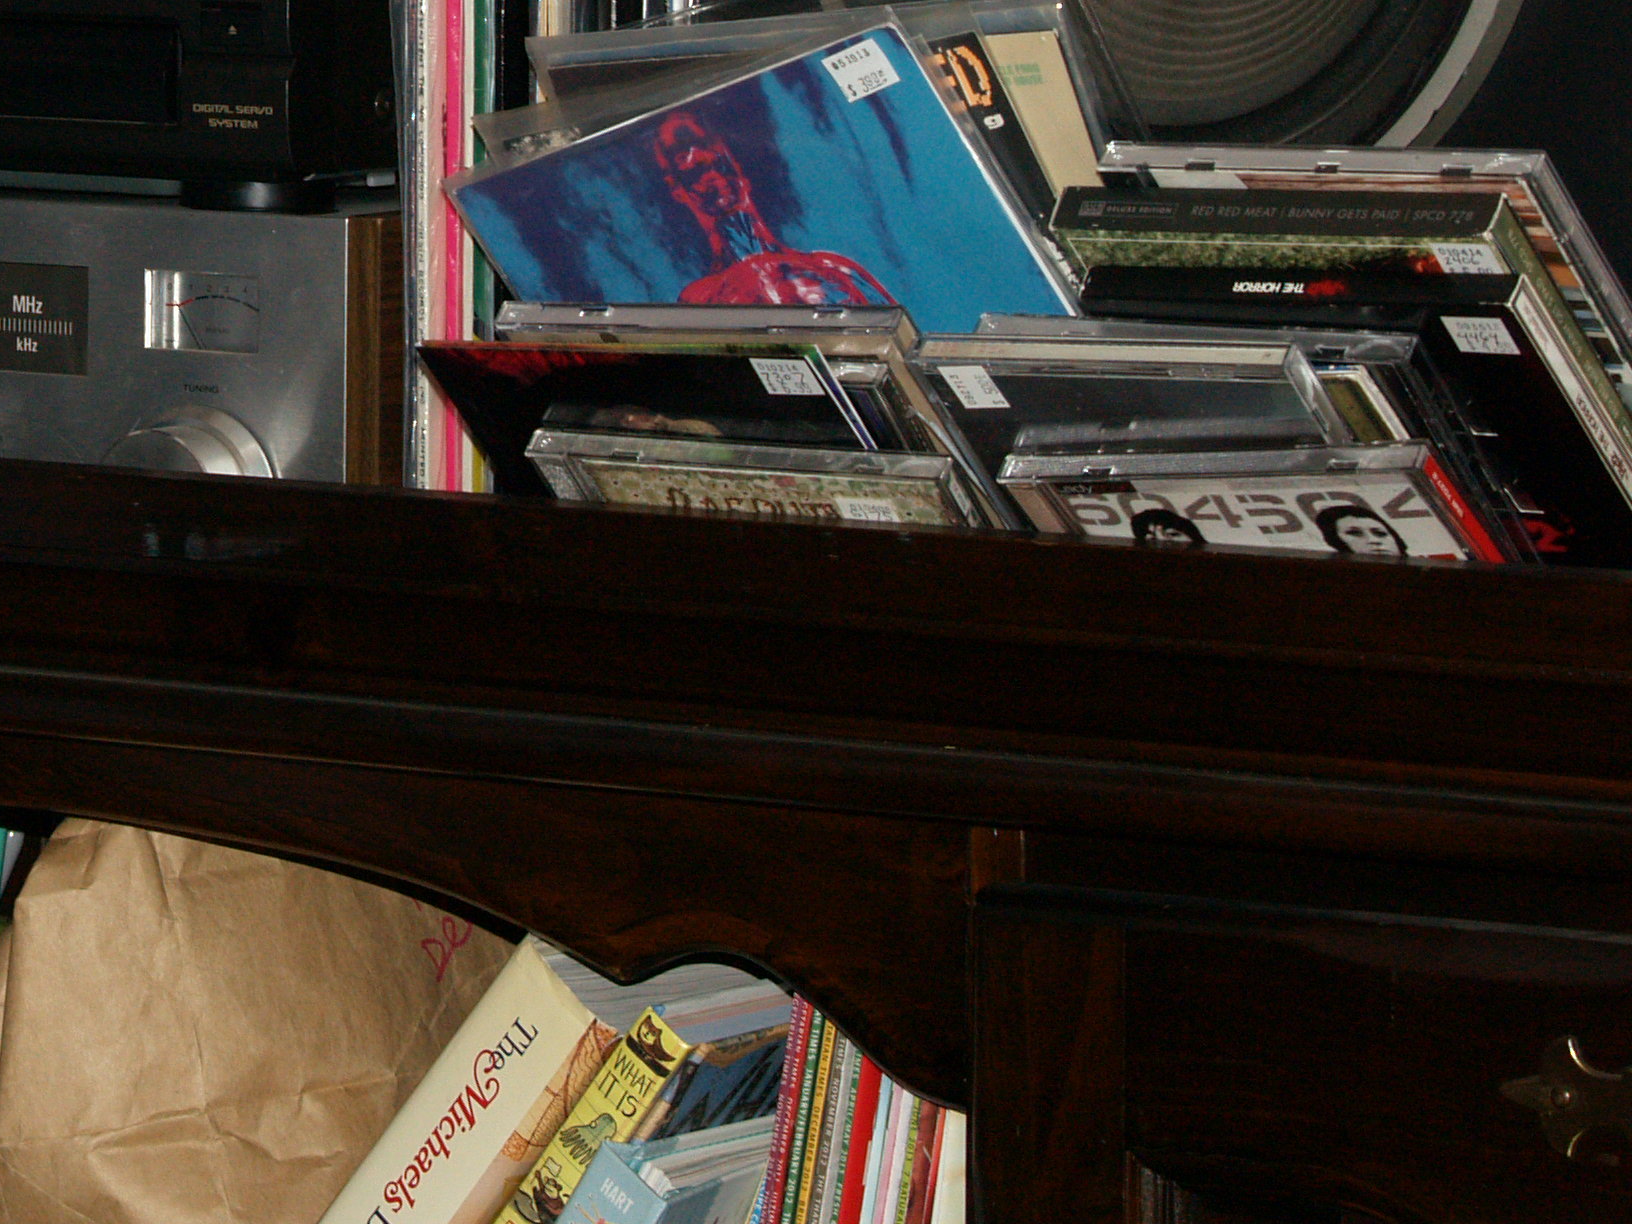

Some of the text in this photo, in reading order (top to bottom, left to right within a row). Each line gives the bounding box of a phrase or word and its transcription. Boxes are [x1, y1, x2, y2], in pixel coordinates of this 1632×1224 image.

[192, 103, 274, 116] DIGITAL SERVO
[208, 117, 259, 129] SYSTEM
[1191, 204, 1215, 216] RED
[1219, 205, 1241, 217] RED
[1244, 206, 1278, 217] MEAT
[1288, 207, 1335, 219] BUNNY
[1338, 208, 1368, 220] GETS
[1371, 209, 1400, 221] PAID
[1412, 209, 1445, 222] SPCD
[1232, 281, 1282, 293] HORROR
[1282, 281, 1305, 293] THE
[12, 294, 43, 314] MHz
[16, 337, 38, 354] kHz
[183, 383, 219, 394] TUNING
[808, 1028, 818, 1060] TIMES
[834, 1038, 845, 1070] TIMES
[614, 1047, 656, 1098] WHAT
[816, 1067, 827, 1097] TIMES
[598, 1070, 639, 1118] IT IS
[823, 1077, 840, 1135] NOVEMBER
[383, 1016, 540, 1213] The Michaels
[779, 1096, 792, 1153] DECEMBER
[790, 1067, 812, 1174] JANUARY/FEBRUARY
[841, 1086, 858, 1145] APRIL/MAY
[804, 1105, 820, 1161] DECEMBER
[819, 1140, 829, 1165] 2012
[786, 1178, 795, 1203] 2012
[800, 1166, 809, 1191] 2012
[599, 1177, 634, 1215] HART
[831, 1182, 843, 1216] FRESH
